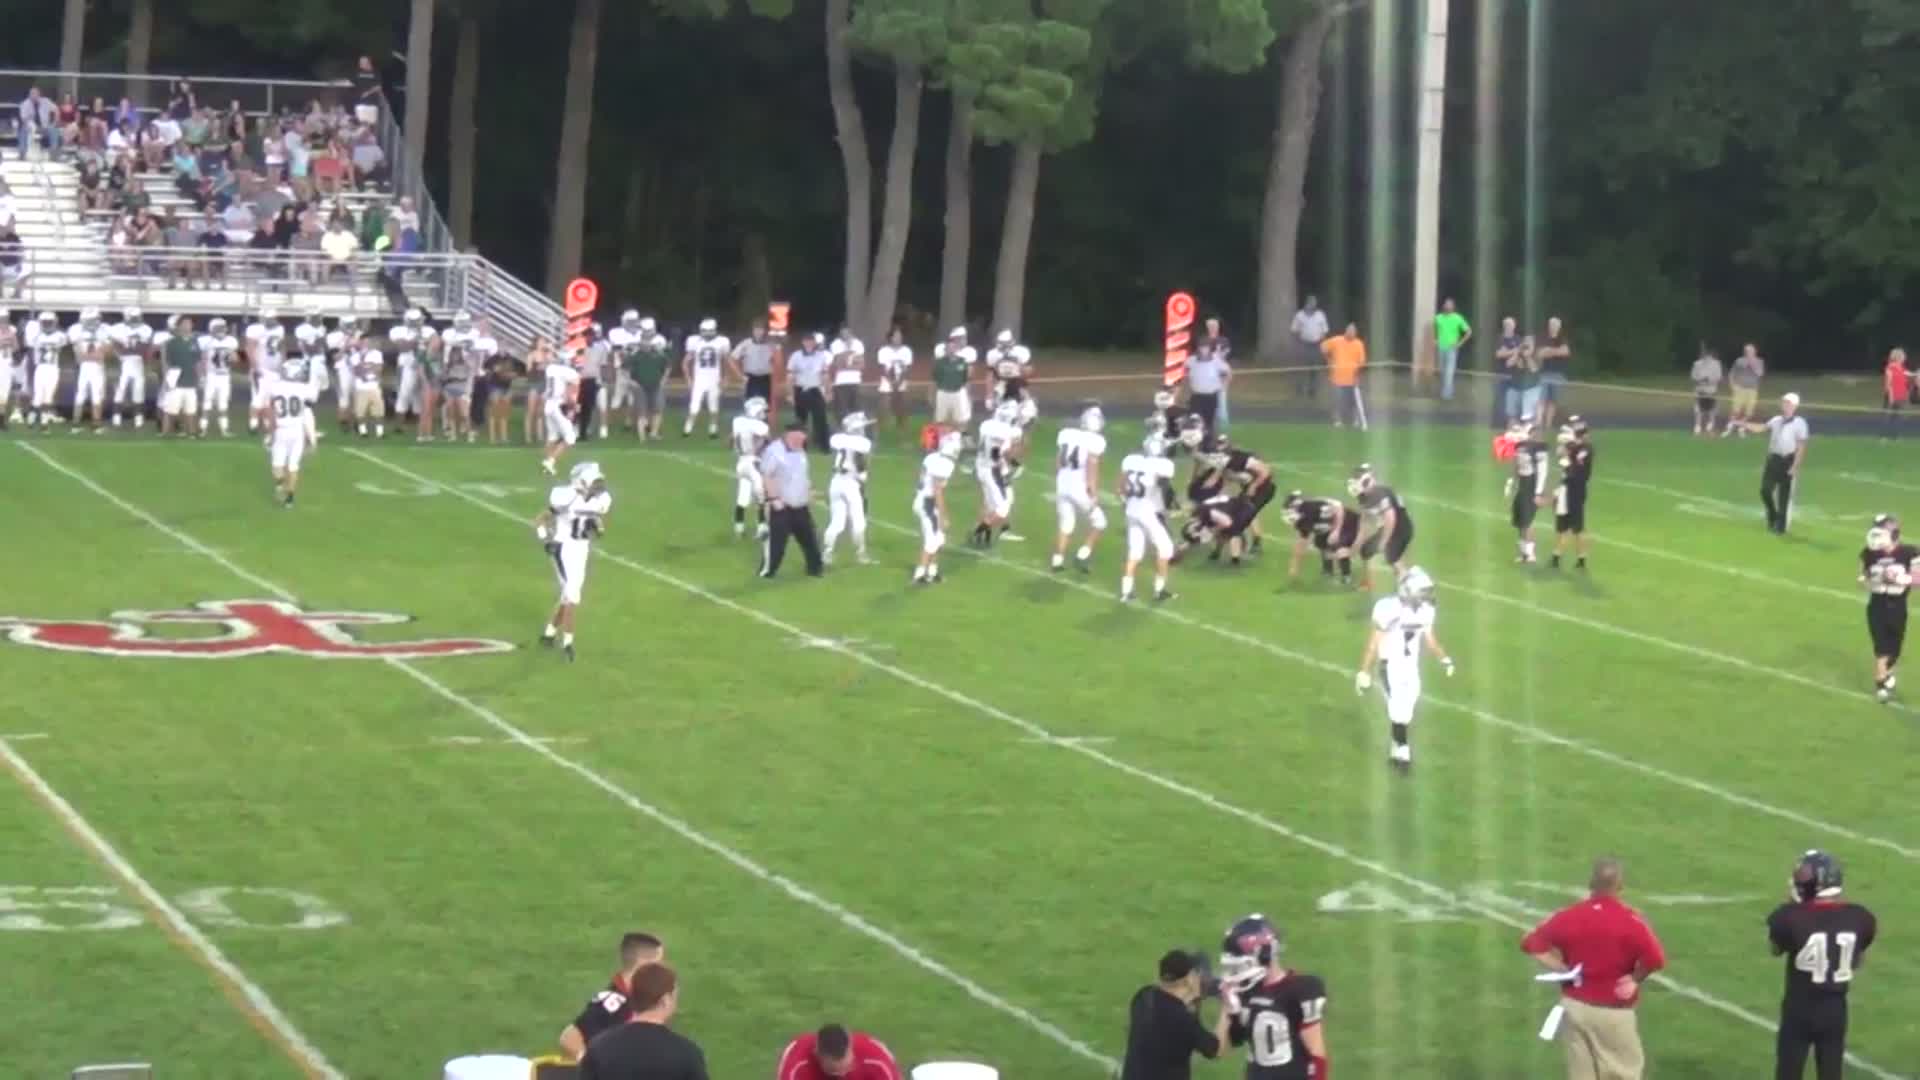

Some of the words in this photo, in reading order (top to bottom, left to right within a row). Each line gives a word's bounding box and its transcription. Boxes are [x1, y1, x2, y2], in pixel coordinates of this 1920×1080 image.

[271, 396, 300, 418] 30
[1126, 470, 1145, 498] 55
[1795, 931, 1857, 983] 41
